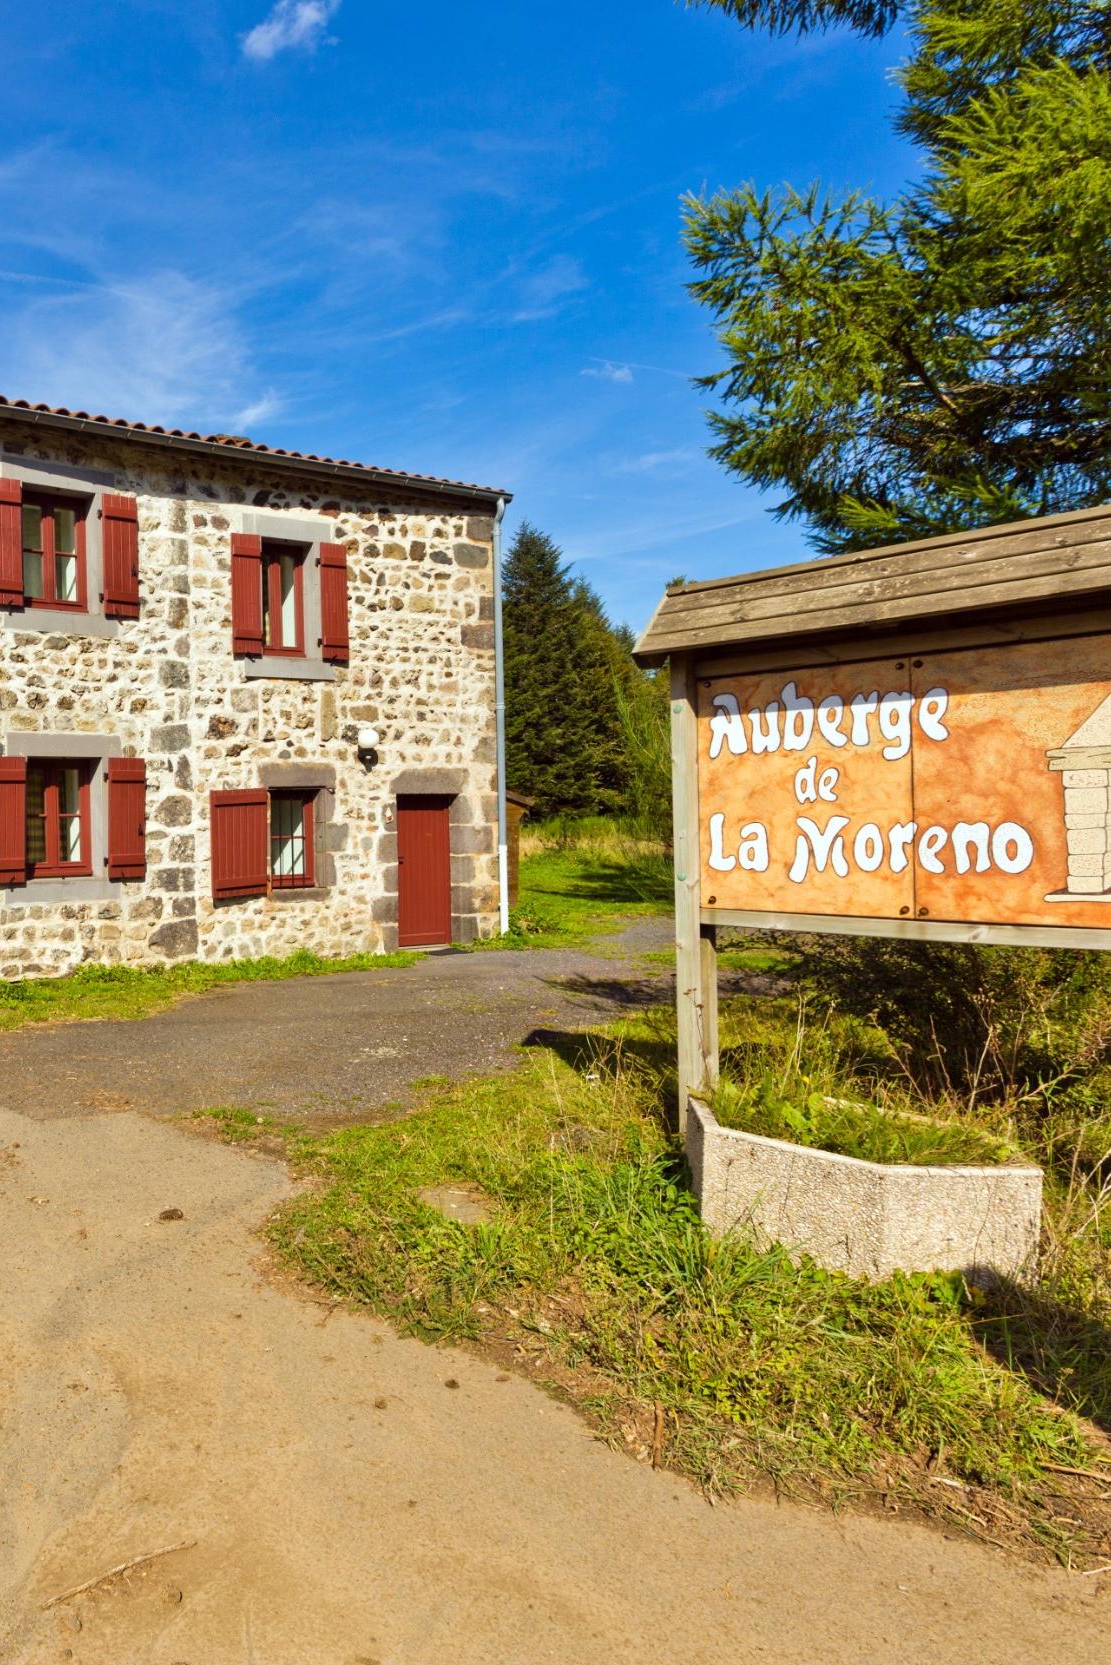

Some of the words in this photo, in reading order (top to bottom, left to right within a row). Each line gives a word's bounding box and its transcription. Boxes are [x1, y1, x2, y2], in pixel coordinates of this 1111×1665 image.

[709, 682, 949, 761] Auberge
[794, 756, 840, 804] de
[708, 812, 770, 872] La
[789, 816, 1034, 883] Moreno
